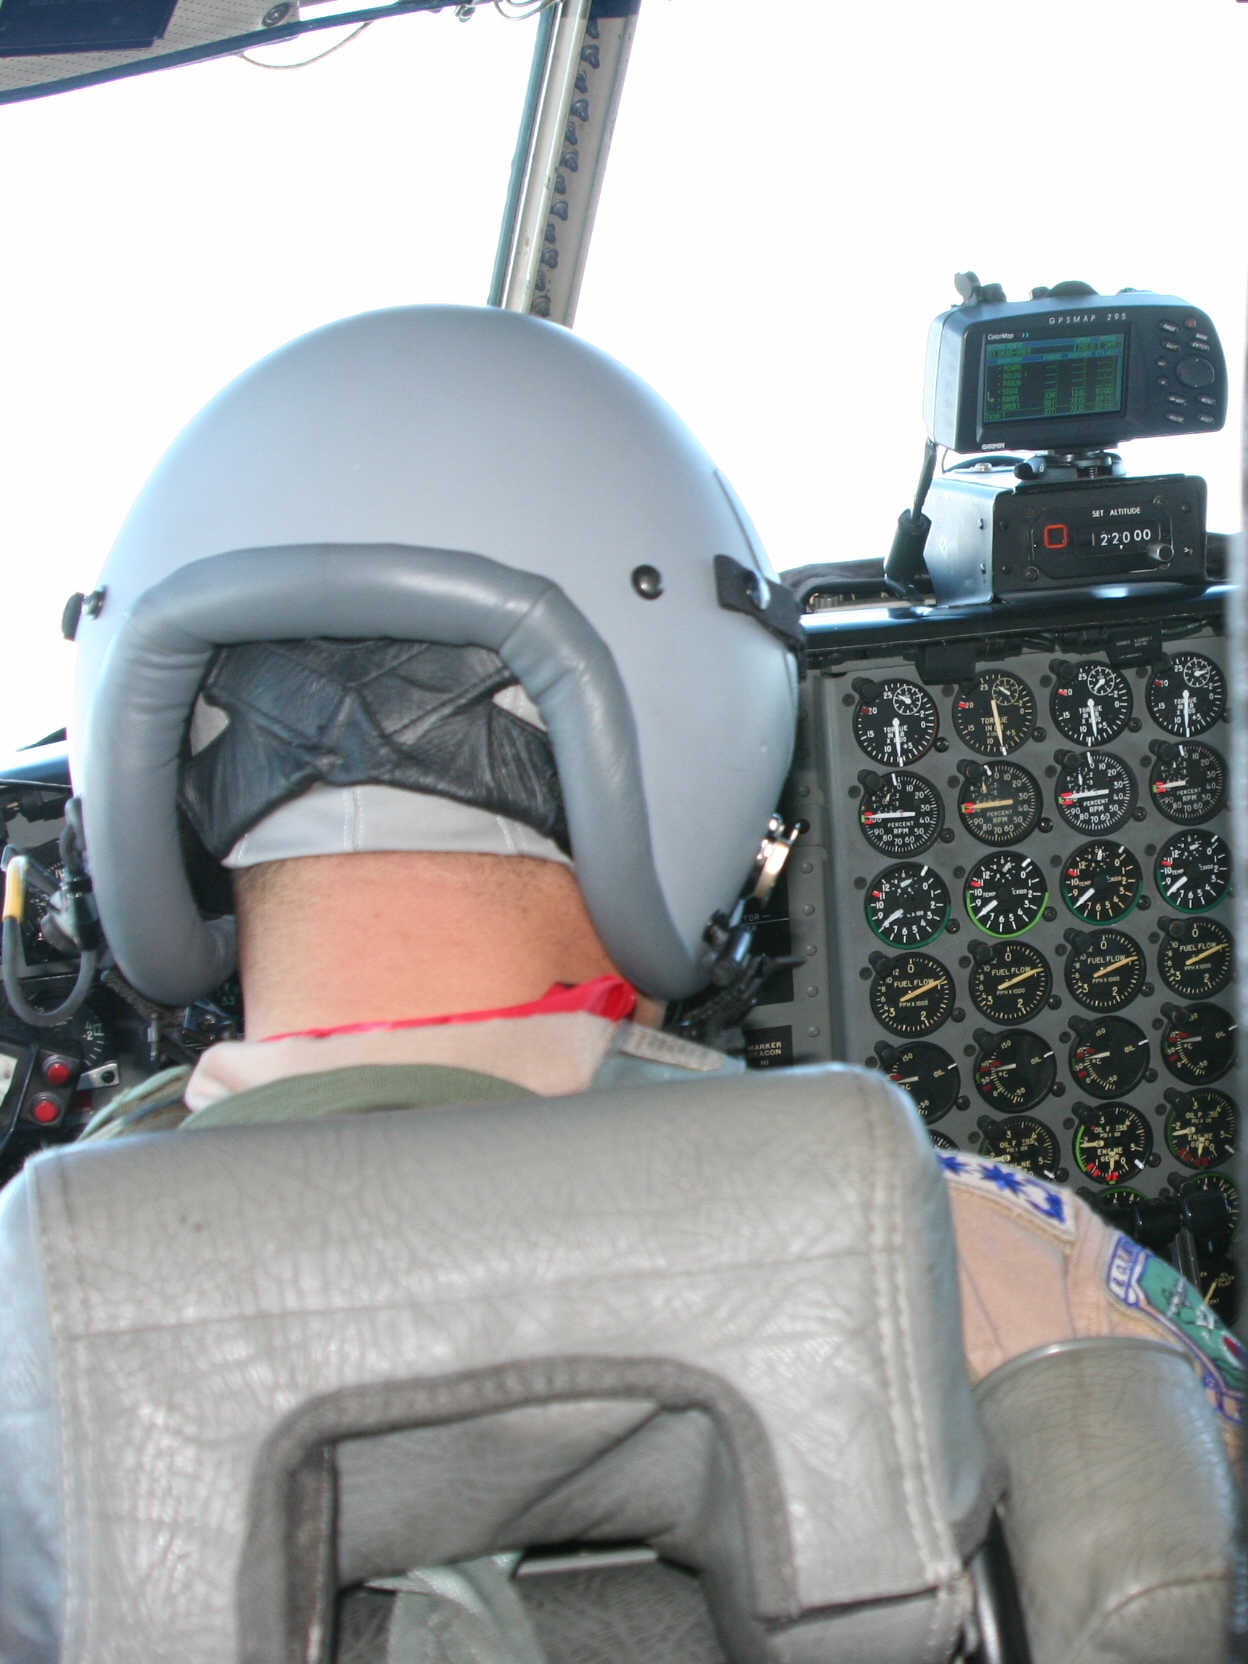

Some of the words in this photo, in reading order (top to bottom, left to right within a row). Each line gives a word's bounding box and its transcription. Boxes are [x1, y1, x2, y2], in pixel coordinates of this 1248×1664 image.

[1049, 314, 1096, 325] GPSMAP
[1092, 509, 1104, 518] SET
[1109, 507, 1141, 516] ALTITUDE
[1100, 529, 1151, 546] 22000
[991, 968, 1009, 976] FUEL
